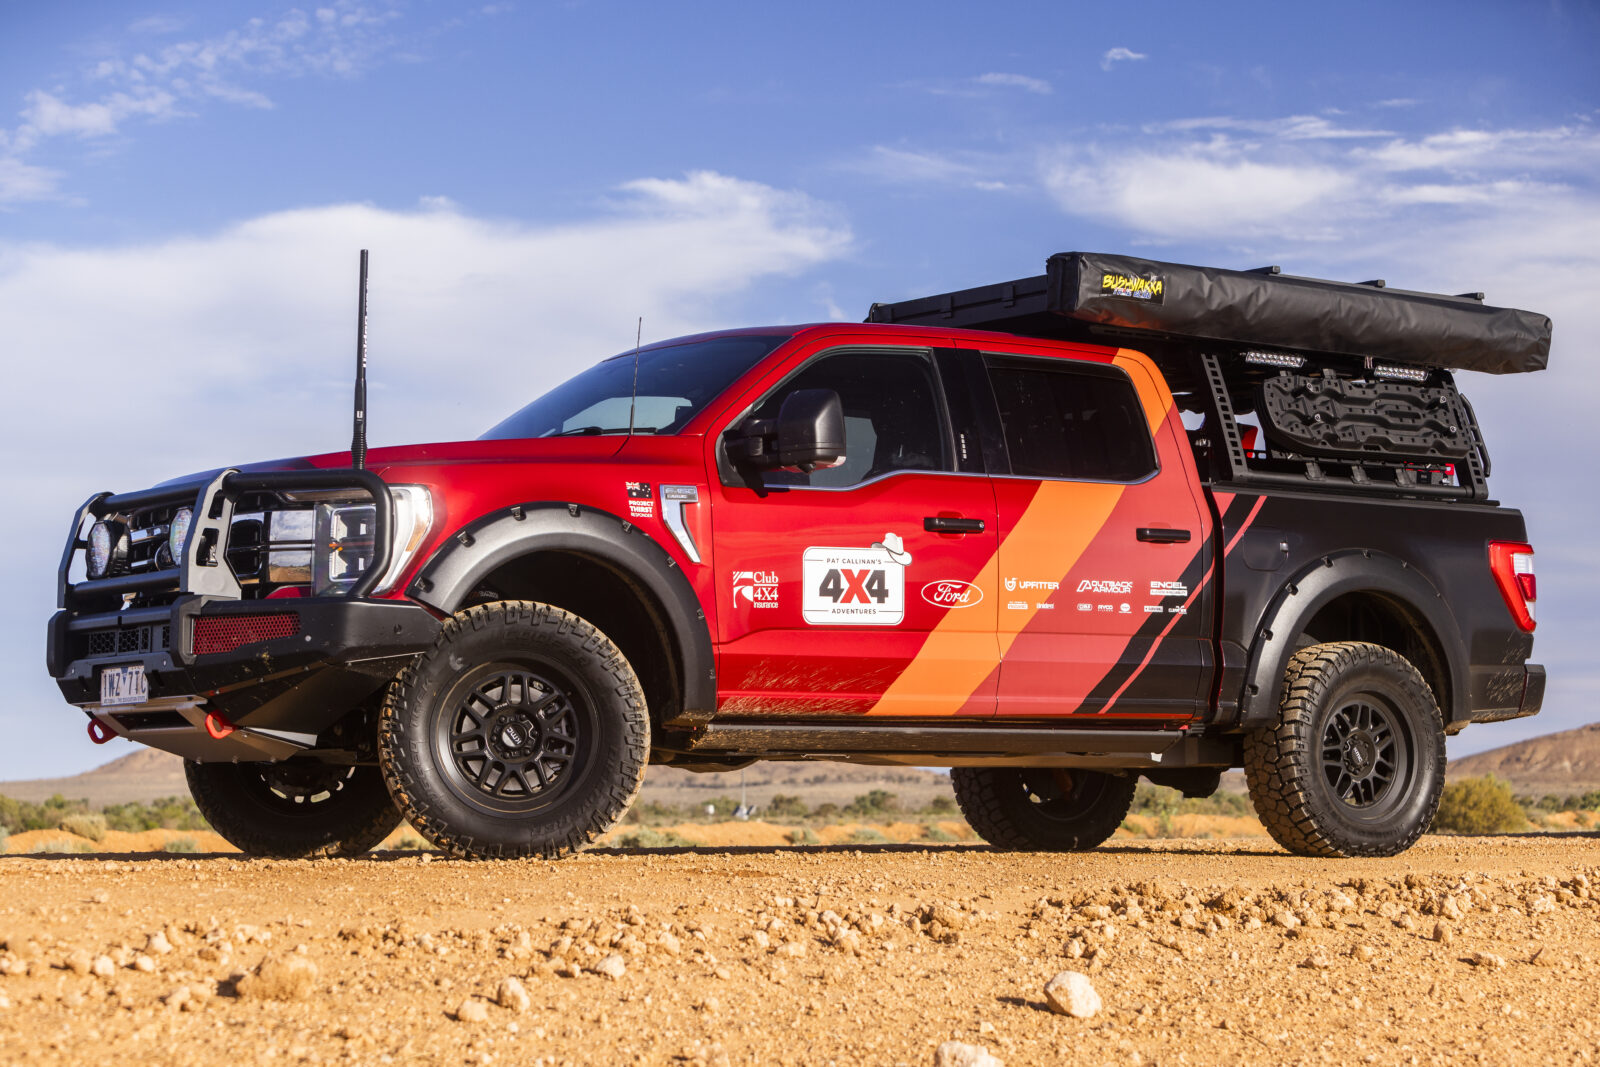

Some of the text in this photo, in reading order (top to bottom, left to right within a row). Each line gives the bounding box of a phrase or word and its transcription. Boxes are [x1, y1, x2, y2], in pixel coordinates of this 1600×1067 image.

[1102, 275, 1163, 295] BUSHWAKKA
[753, 571, 779, 583] Club
[818, 568, 889, 604] 4X4
[1019, 581, 1060, 590] UPFITTER
[1091, 580, 1133, 588] OUTBACK
[1150, 581, 1188, 590] ENGEL
[753, 587, 779, 601] 4X4
[933, 582, 971, 603] Ford
[1092, 586, 1132, 594] ARMOUR
[753, 601, 779, 609] Insurance
